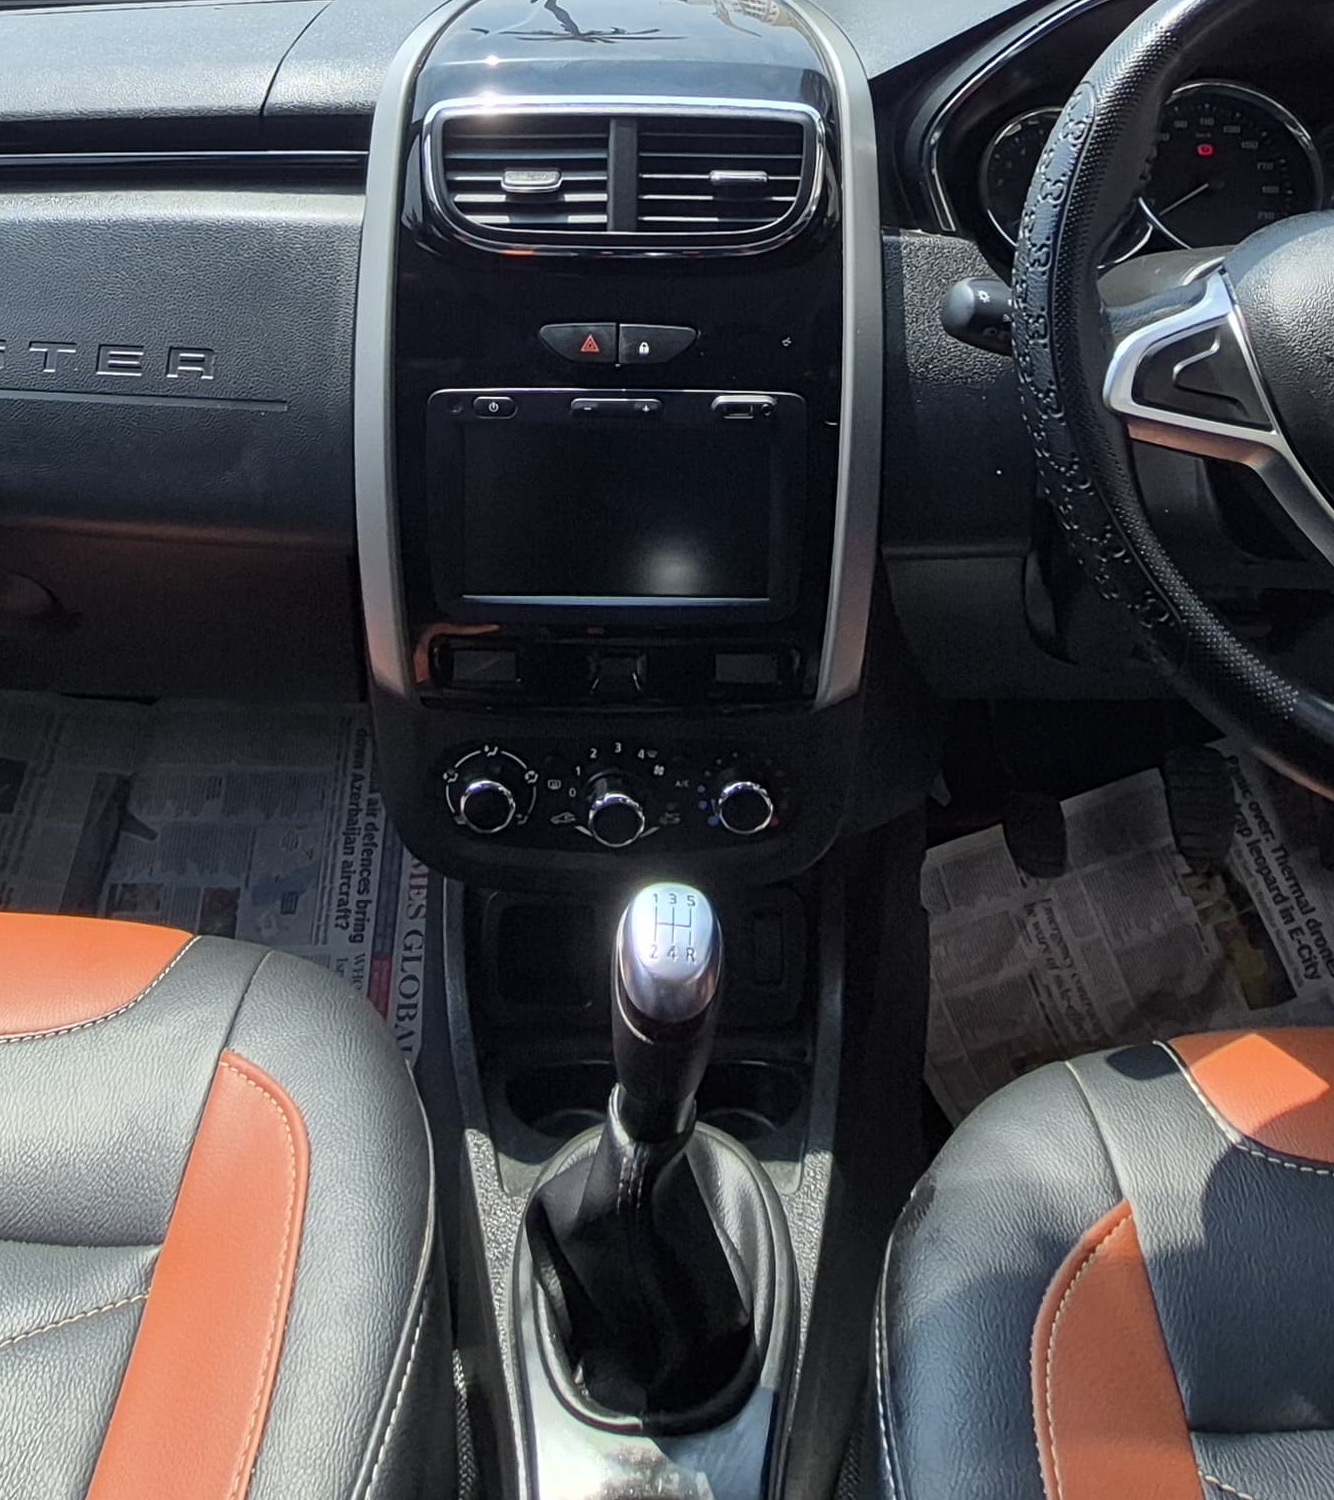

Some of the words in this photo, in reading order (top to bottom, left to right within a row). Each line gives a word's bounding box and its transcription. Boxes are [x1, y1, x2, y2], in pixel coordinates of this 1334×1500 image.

[353, 728, 368, 770] down
[590, 748, 598, 759] 2
[614, 742, 622, 753] 3
[367, 798, 382, 819] air
[569, 787, 577, 797] 0
[342, 774, 366, 856] Azerbaijan
[358, 822, 380, 896] defences
[1248, 802, 1275, 842] over:
[1271, 846, 1315, 917] Thermal
[334, 859, 356, 931] aircraft?
[669, 893, 677, 904] 3
[686, 895, 696, 907] 5
[1246, 836, 1286, 906] leopard
[1279, 904, 1295, 926] in
[1288, 927, 1322, 980] E-City
[349, 900, 372, 944] bring
[650, 944, 658, 959] 2
[667, 945, 676, 958] 4
[686, 947, 695, 962] R
